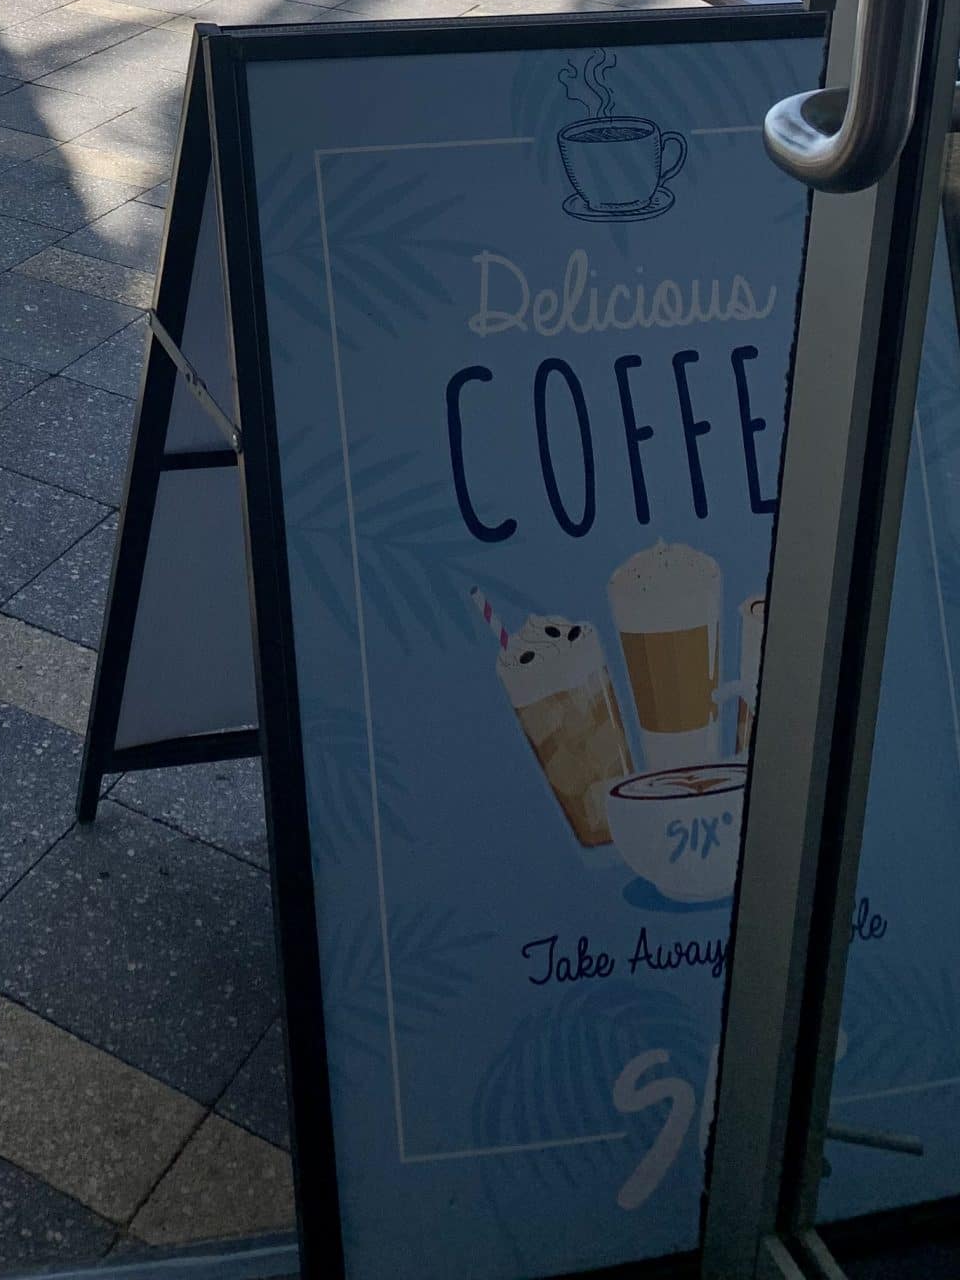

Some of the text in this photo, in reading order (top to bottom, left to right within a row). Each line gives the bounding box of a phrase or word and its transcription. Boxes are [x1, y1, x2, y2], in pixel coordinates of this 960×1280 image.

[468, 249, 777, 338] Delicious
[446, 345, 782, 543] COFFE
[522, 927, 728, 986] Take Away
